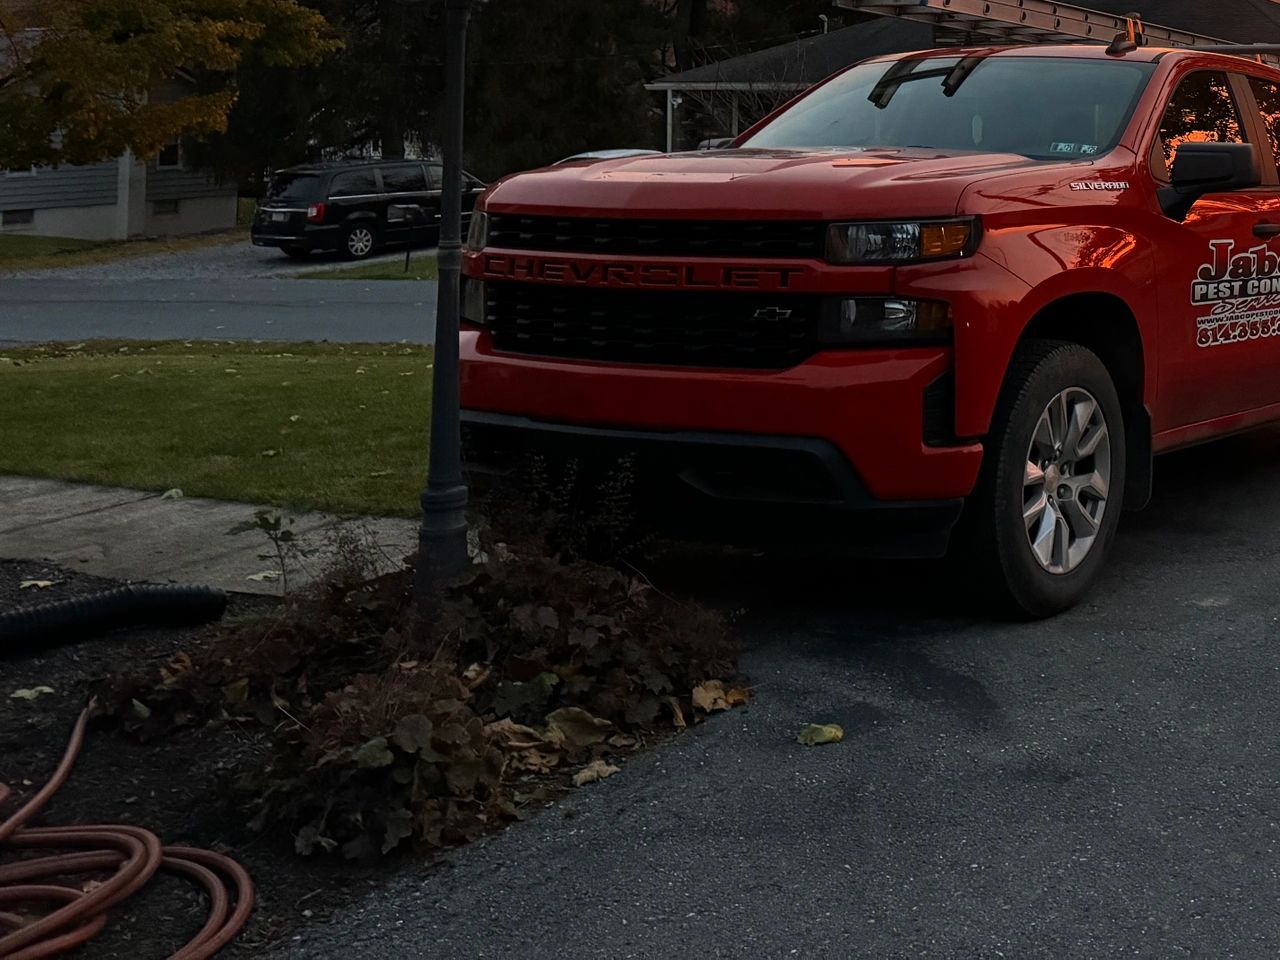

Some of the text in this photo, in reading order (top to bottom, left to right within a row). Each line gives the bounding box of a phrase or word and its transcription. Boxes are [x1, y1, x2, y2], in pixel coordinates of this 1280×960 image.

[1070, 181, 1130, 191] SILVERADO
[483, 255, 805, 290] CHEVROLET
[1194, 281, 1244, 301] PEST
